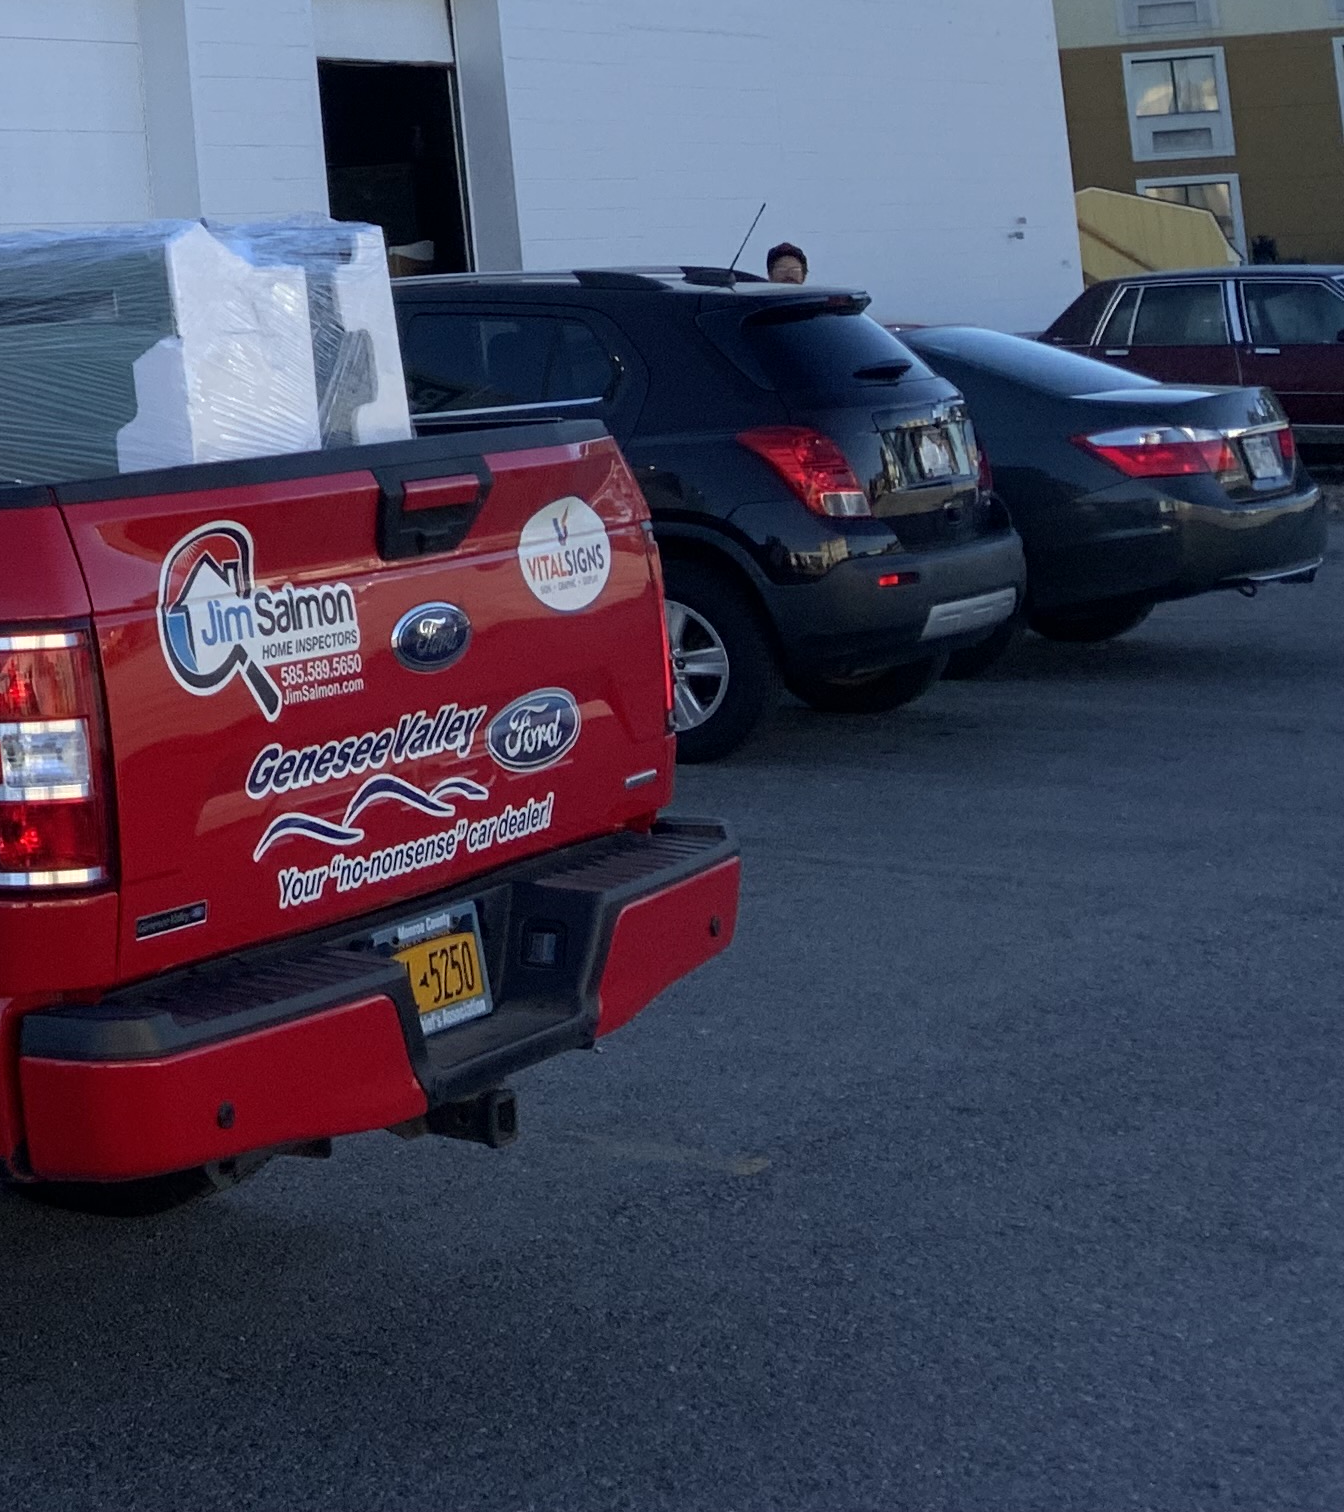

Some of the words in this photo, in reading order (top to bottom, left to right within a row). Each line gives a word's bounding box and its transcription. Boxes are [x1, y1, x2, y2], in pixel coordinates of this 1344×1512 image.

[526, 544, 605, 582] VITALSIGNS
[201, 599, 254, 646] Jim
[254, 588, 354, 636] Salmon
[262, 640, 293, 660] HOME
[295, 630, 358, 654] INSPECTORS
[280, 653, 362, 687] 585.589.5650
[283, 677, 364, 706] JimSalmon.com
[247, 730, 395, 797] Genesee
[394, 705, 486, 763] Valley
[505, 702, 562, 758] Ford
[280, 868, 325, 907] Your
[468, 817, 496, 849] car
[498, 793, 554, 841] dealer!
